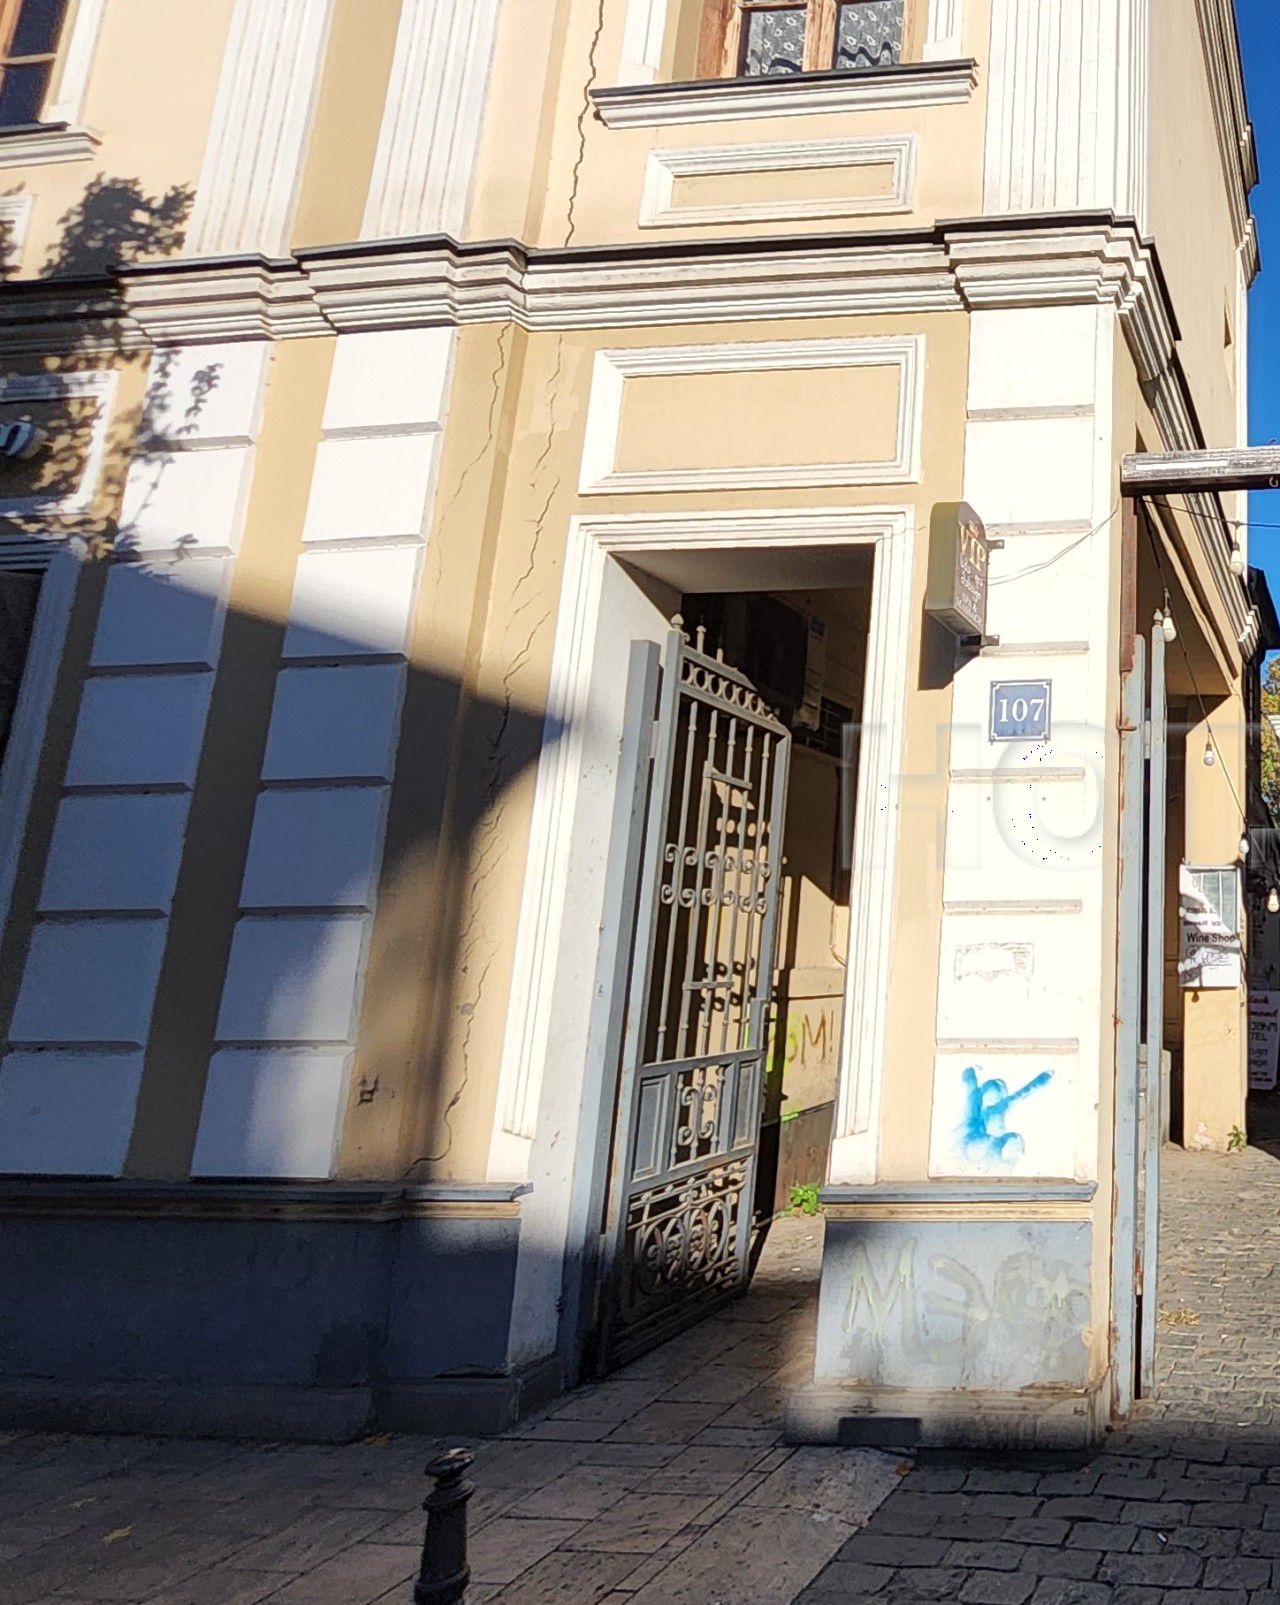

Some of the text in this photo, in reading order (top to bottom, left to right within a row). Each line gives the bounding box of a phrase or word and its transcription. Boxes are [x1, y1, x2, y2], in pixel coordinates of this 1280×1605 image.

[958, 521, 987, 571] VIP
[999, 698, 1045, 722] 107
[1186, 932, 1237, 945] Wine Shop
